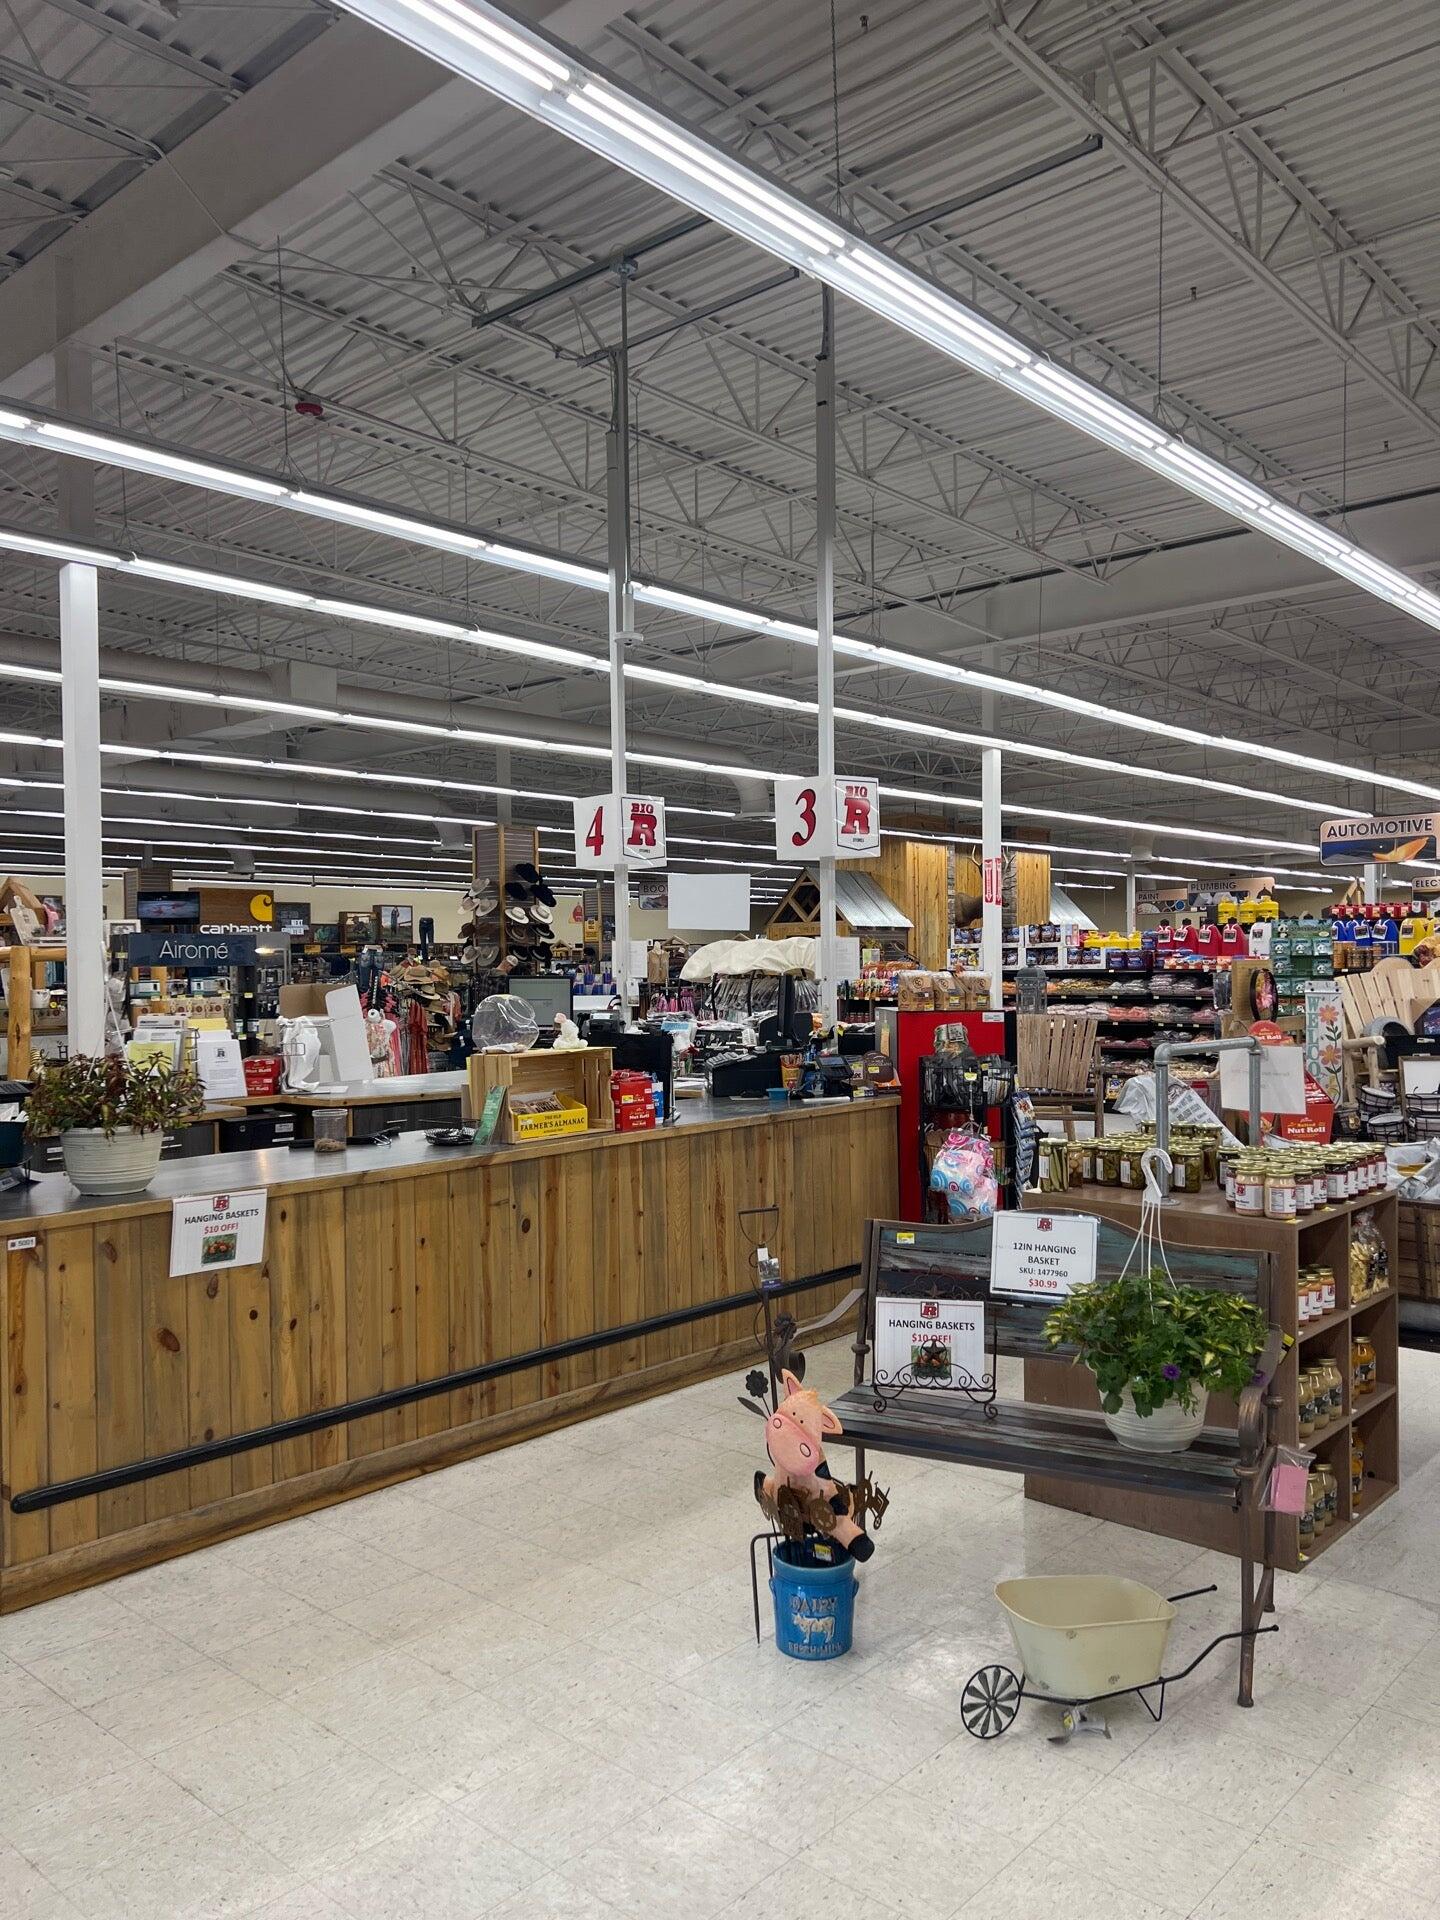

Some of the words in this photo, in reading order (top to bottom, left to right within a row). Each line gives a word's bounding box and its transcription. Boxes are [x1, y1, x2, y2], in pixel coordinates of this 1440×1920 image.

[845, 785, 868, 797] BIG
[630, 803, 654, 814] BIG
[791, 788, 817, 847] 3
[841, 798, 871, 834] R
[585, 805, 605, 857] 4
[626, 813, 658, 847] R
[1326, 818, 1433, 838] AUTOMOTIVE
[1190, 881, 1237, 891] PLUMBING
[1138, 893, 1160, 901] PAINT
[200, 923, 273, 935] carhartt
[159, 940, 229, 960] Airomé
[520, 1120, 554, 1132] FARMER'S
[554, 1117, 585, 1128] ALMANAC
[184, 1212, 224, 1225] HANGING
[225, 1208, 259, 1220] BASKETS
[203, 1225, 218, 1235] $10
[220, 1222, 239, 1232] OFF!
[1012, 1242, 1033, 1251] 12IN
[1034, 1244, 1077, 1255] HANGING
[1027, 1255, 1060, 1266] BASKET
[1019, 1266, 1036, 1275] SKU:
[1037, 1268, 1068, 1278] 1477960
[1028, 1278, 1058, 1289] $30.99
[888, 1319, 933, 1329] HANGING
[935, 1321, 975, 1331] BASKETS
[911, 1332, 929, 1343] $10
[930, 1334, 952, 1344] OFF!
